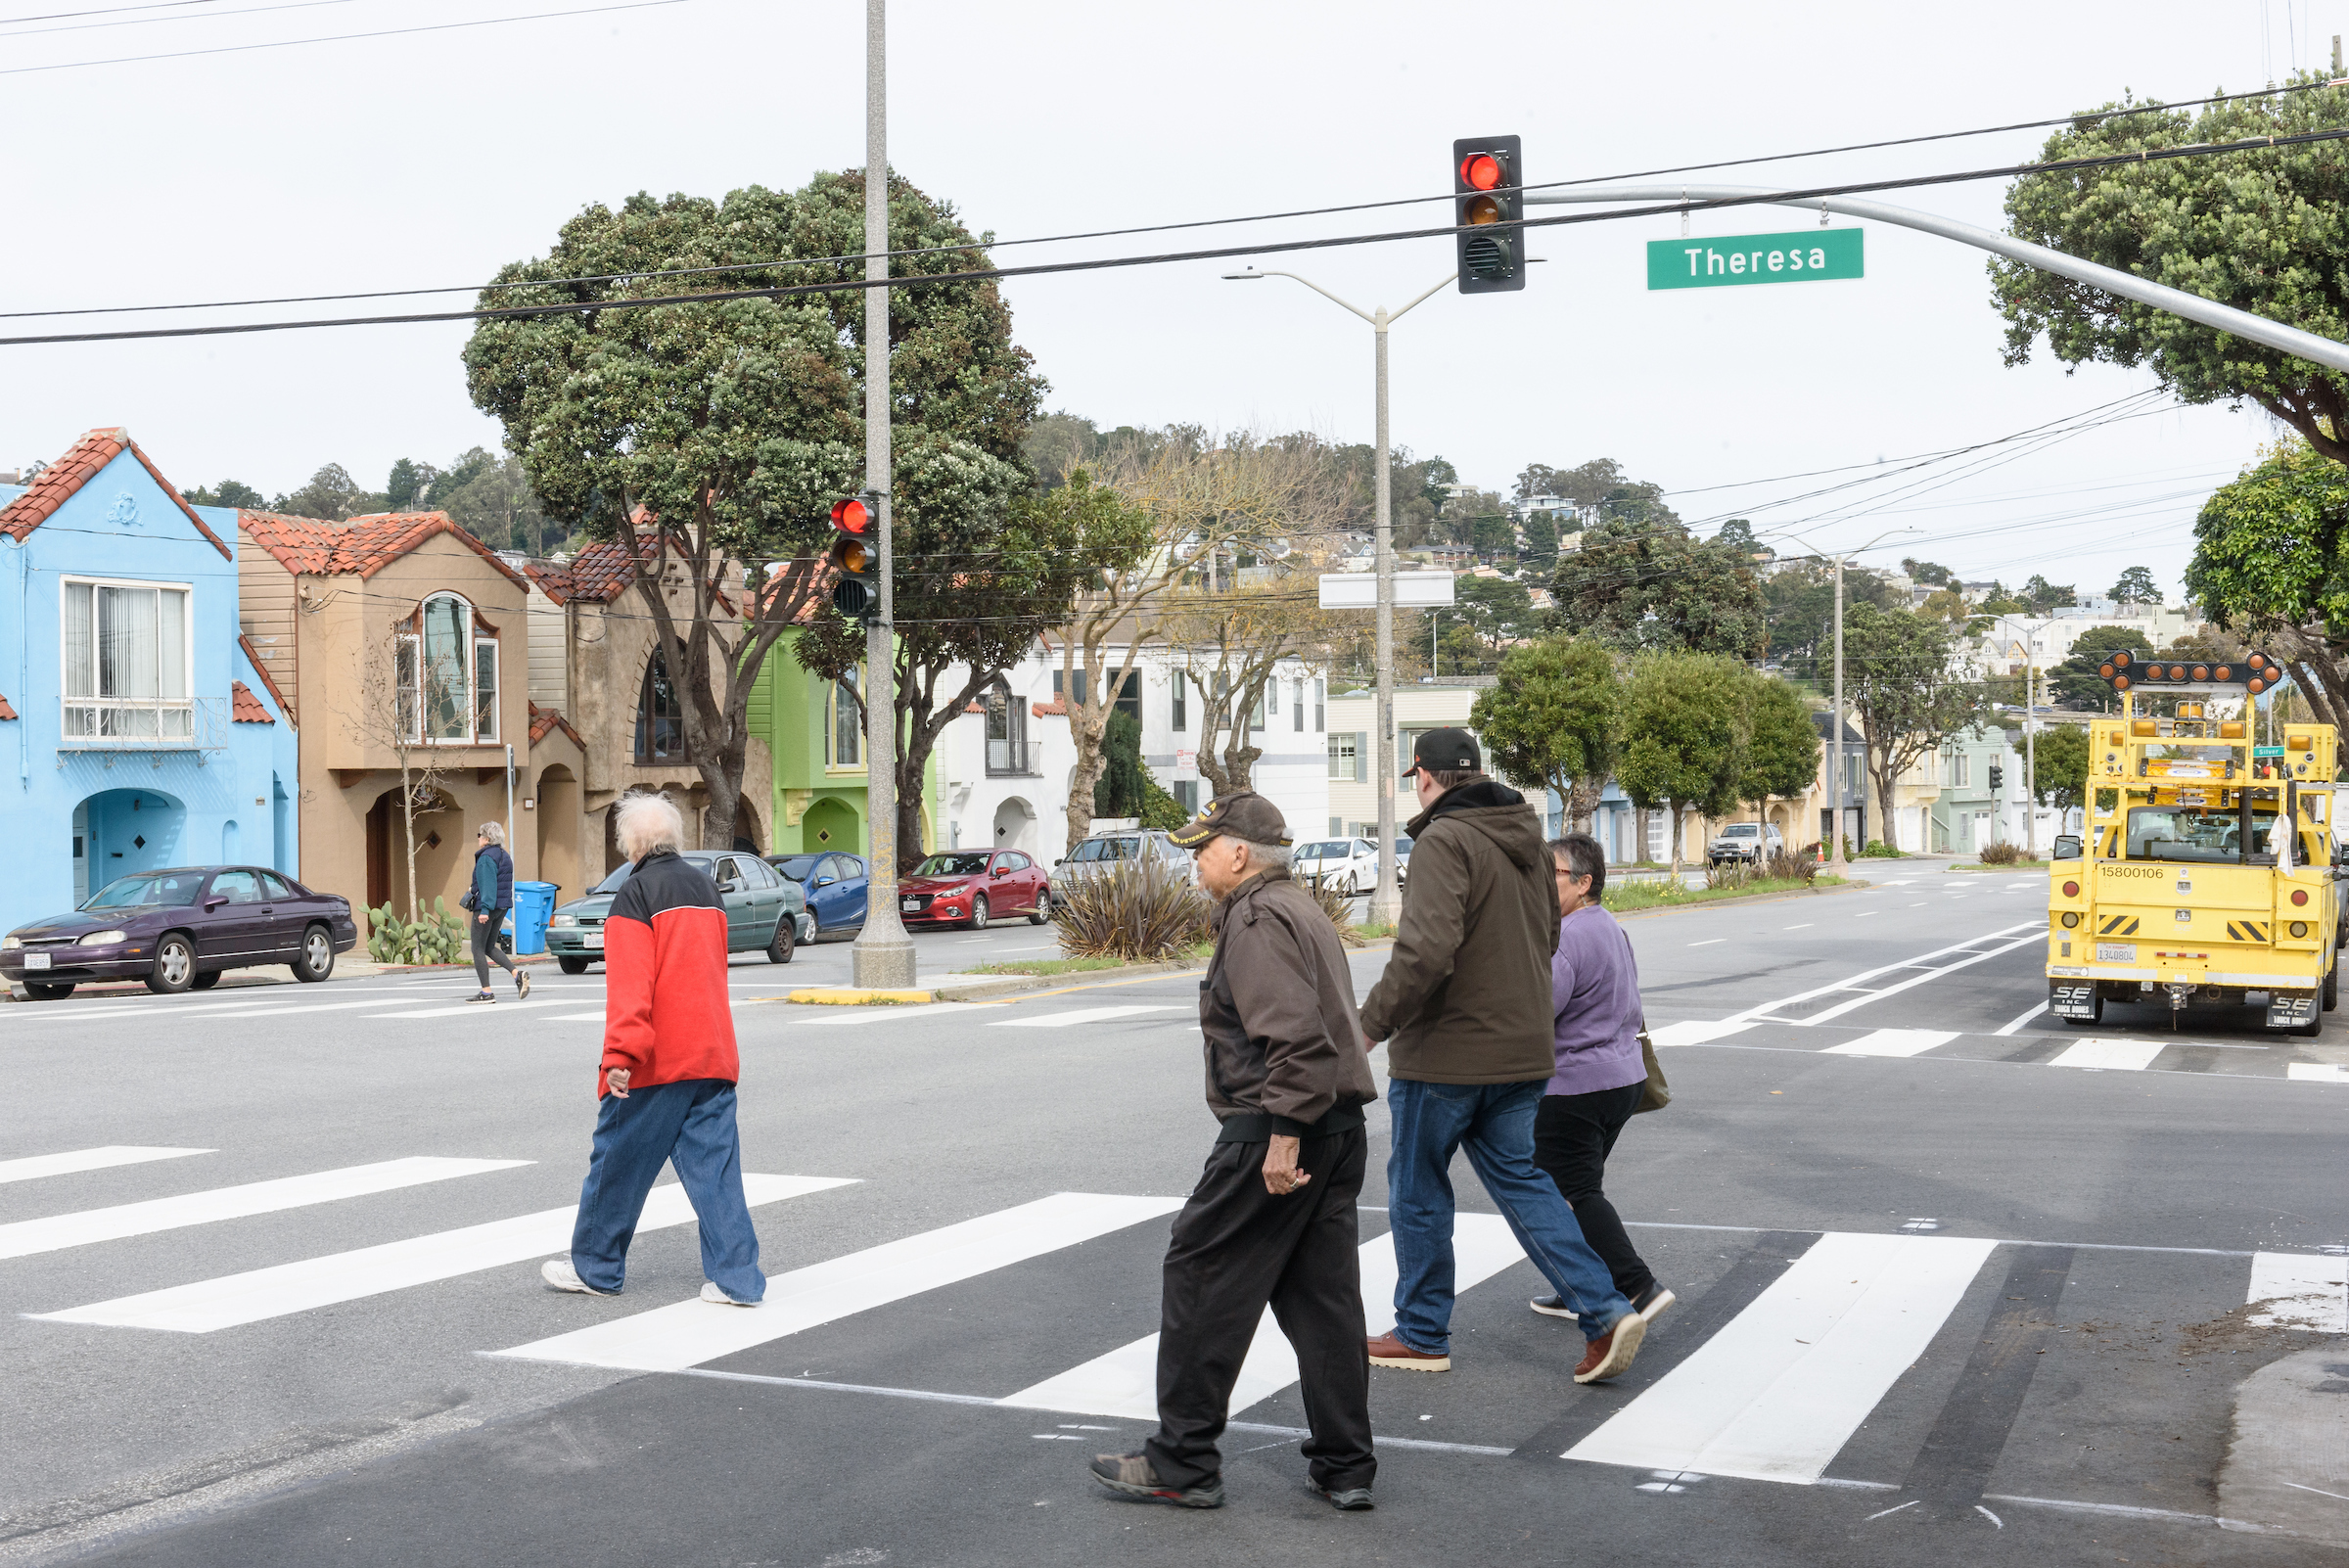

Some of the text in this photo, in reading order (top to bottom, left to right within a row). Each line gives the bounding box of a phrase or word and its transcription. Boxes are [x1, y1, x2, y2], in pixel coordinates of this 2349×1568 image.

[1684, 248, 1825, 276] Theresa
[1179, 830, 1210, 844] VETERAN
[2101, 867, 2164, 878] 15800106
[2098, 949, 2134, 960] 1340804
[2052, 986, 2092, 999] SE
[2054, 1004, 2090, 1014] TRUCK BODIES
[2272, 996, 2313, 1011] SE
[2274, 1015, 2290, 1025] TRUCK
